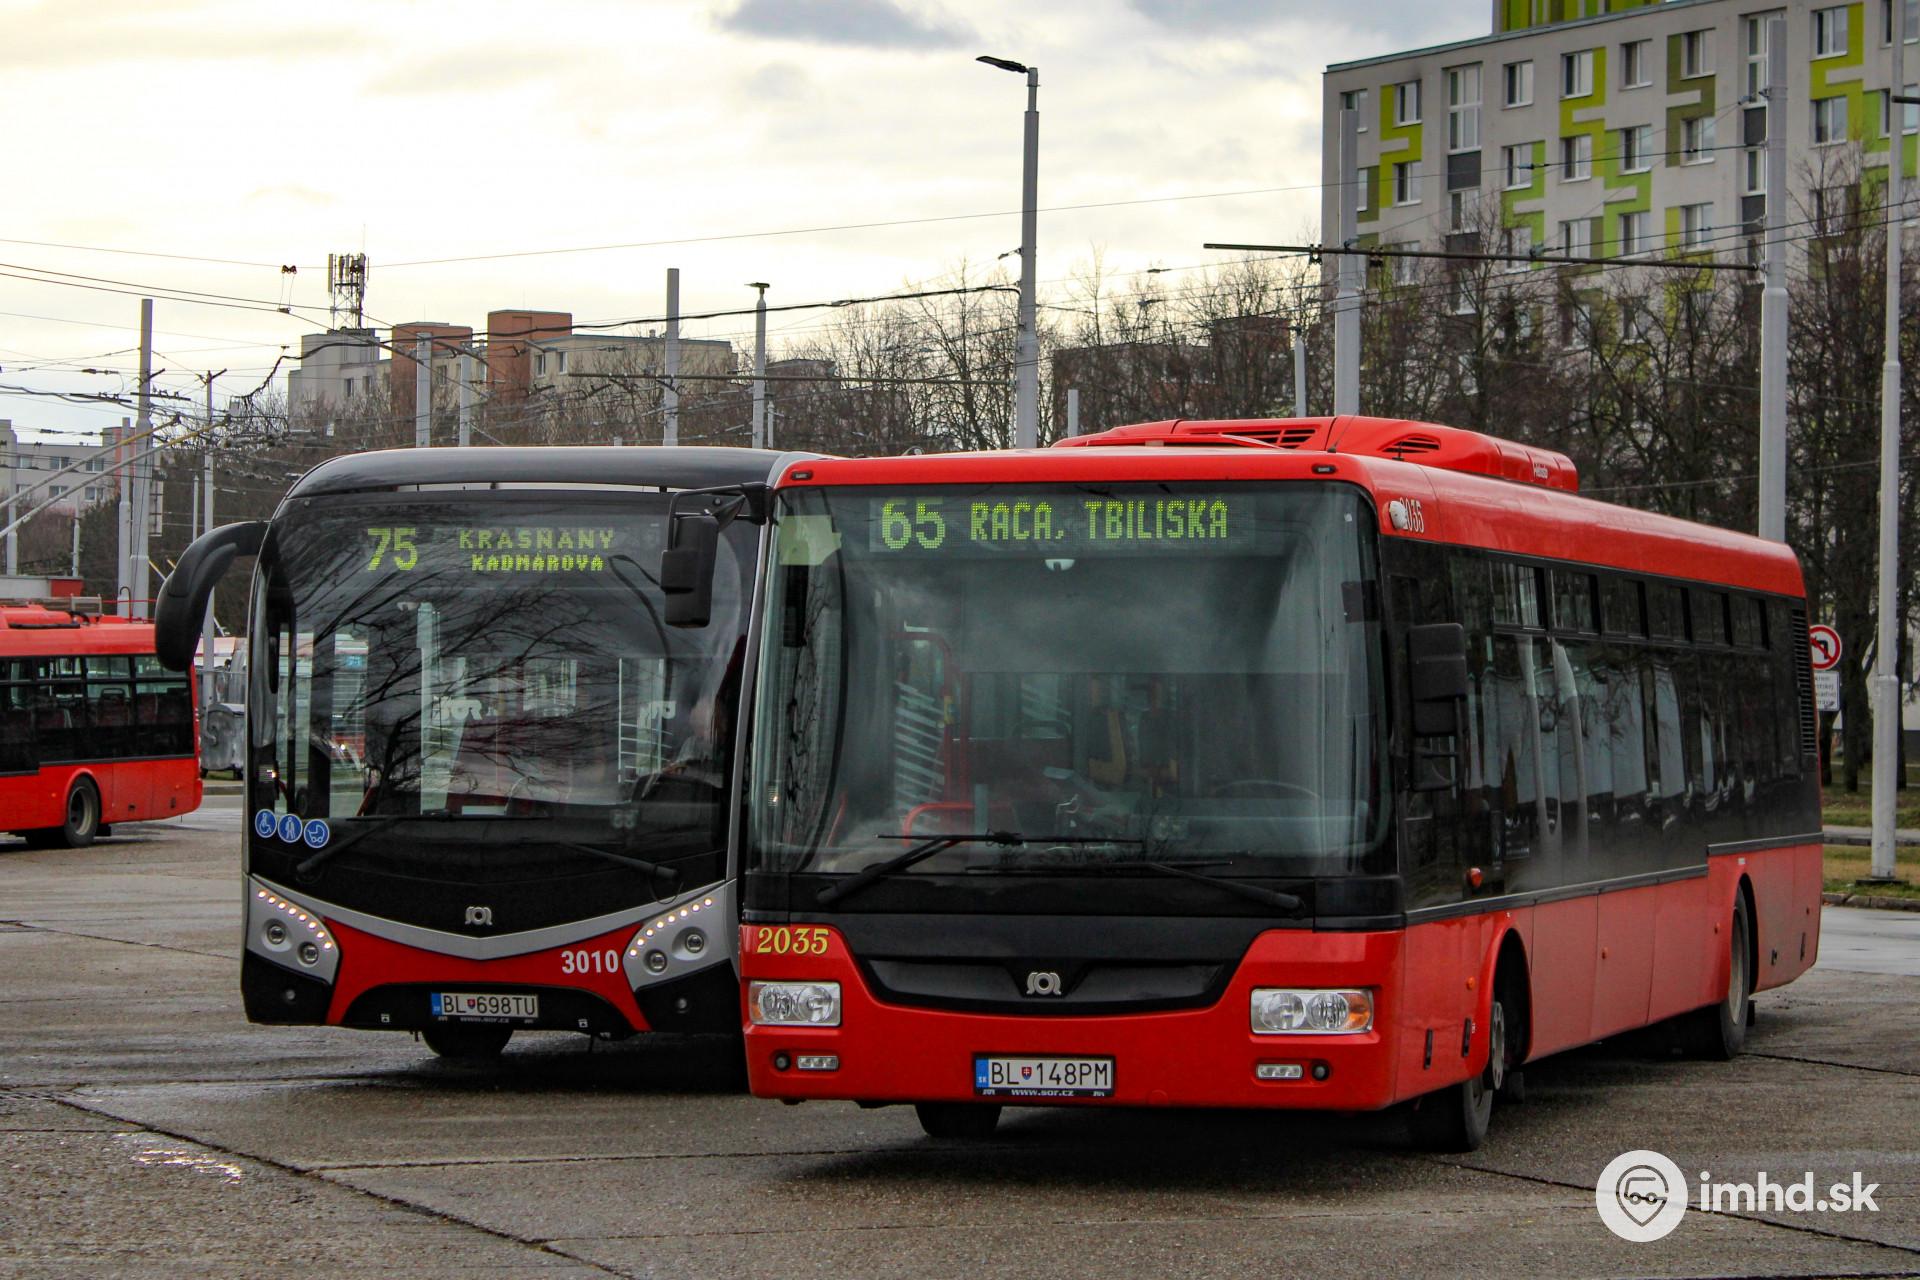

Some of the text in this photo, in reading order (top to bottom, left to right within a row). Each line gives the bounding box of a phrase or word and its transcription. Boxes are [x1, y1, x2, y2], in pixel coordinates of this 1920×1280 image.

[882, 499, 945, 549] 65
[368, 528, 418, 571] 75
[757, 927, 829, 954] 2035
[561, 950, 619, 974] 3010
[443, 995, 535, 1016] BL 698TU
[991, 1062, 1108, 1086] BL 148PM
[1011, 1088, 1074, 1097] www.sor.cz
